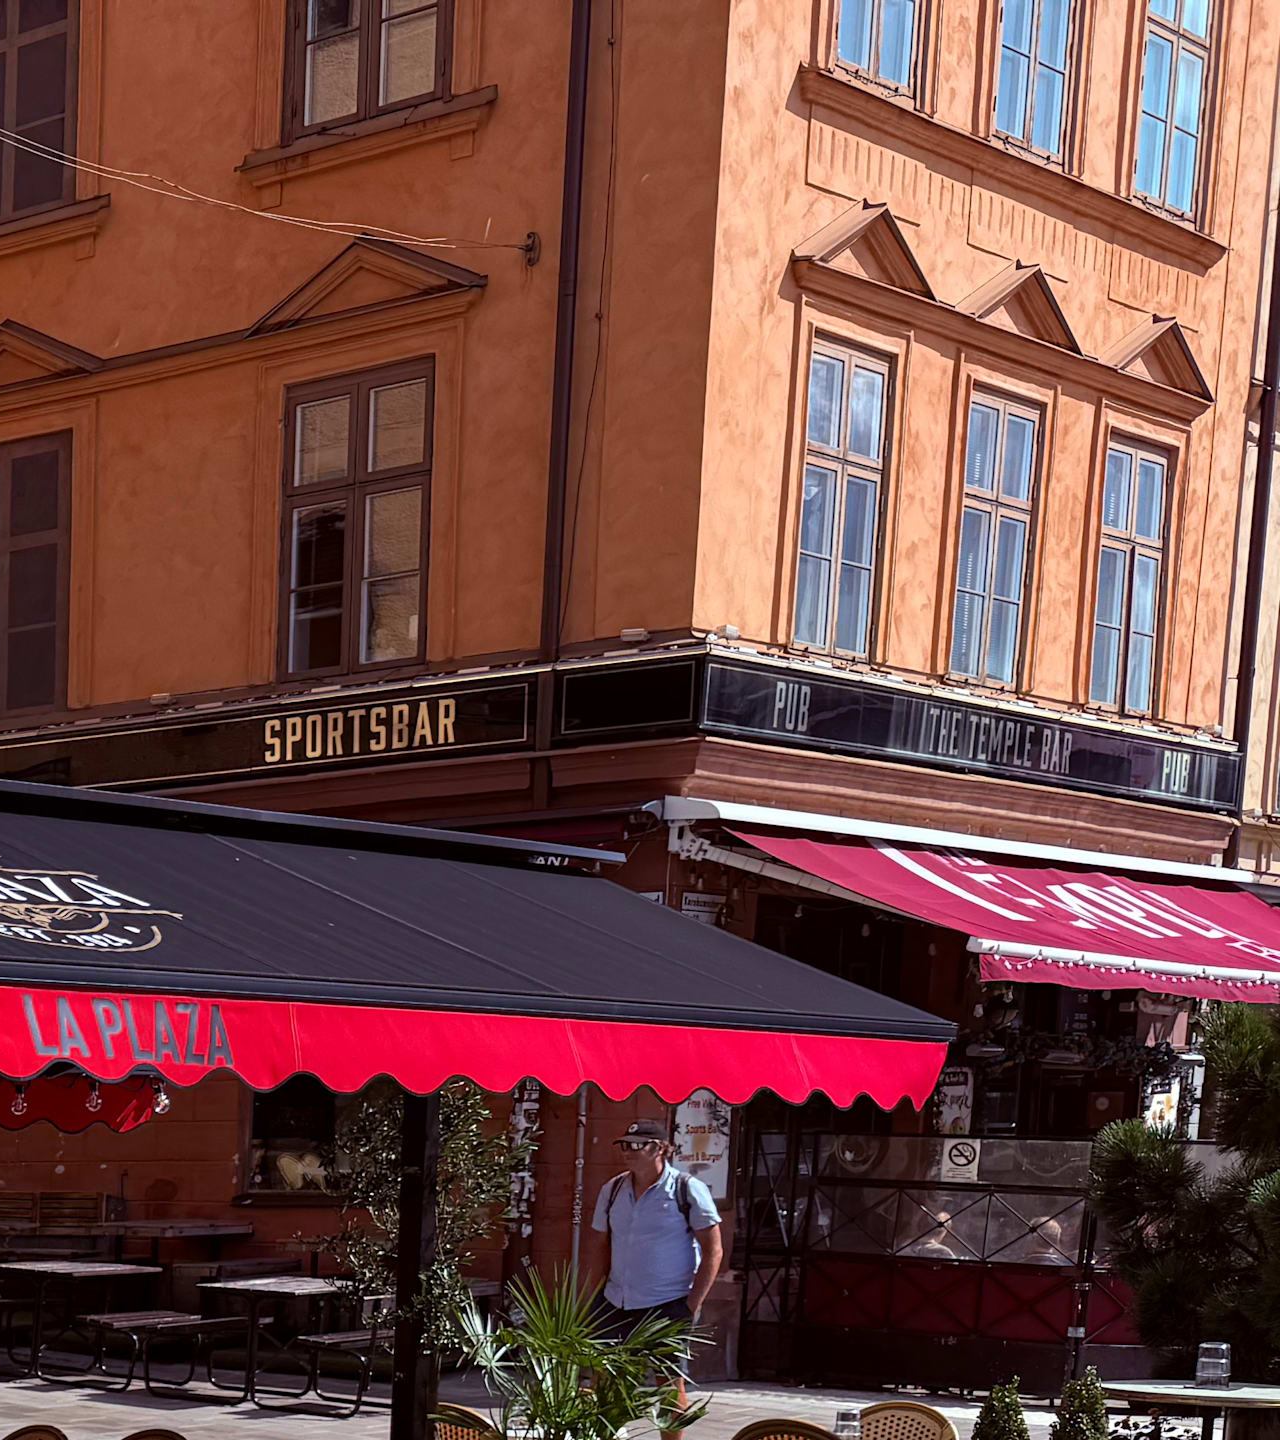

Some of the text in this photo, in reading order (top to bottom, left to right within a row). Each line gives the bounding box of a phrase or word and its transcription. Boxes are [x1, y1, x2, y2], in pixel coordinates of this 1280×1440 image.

[264, 698, 456, 763] SPORTSBAR
[773, 681, 811, 732] PUB
[929, 708, 1073, 775] THE TEMPLE BAR
[1161, 750, 1190, 794] PUB
[22, 994, 234, 1066] LA PLAZA
